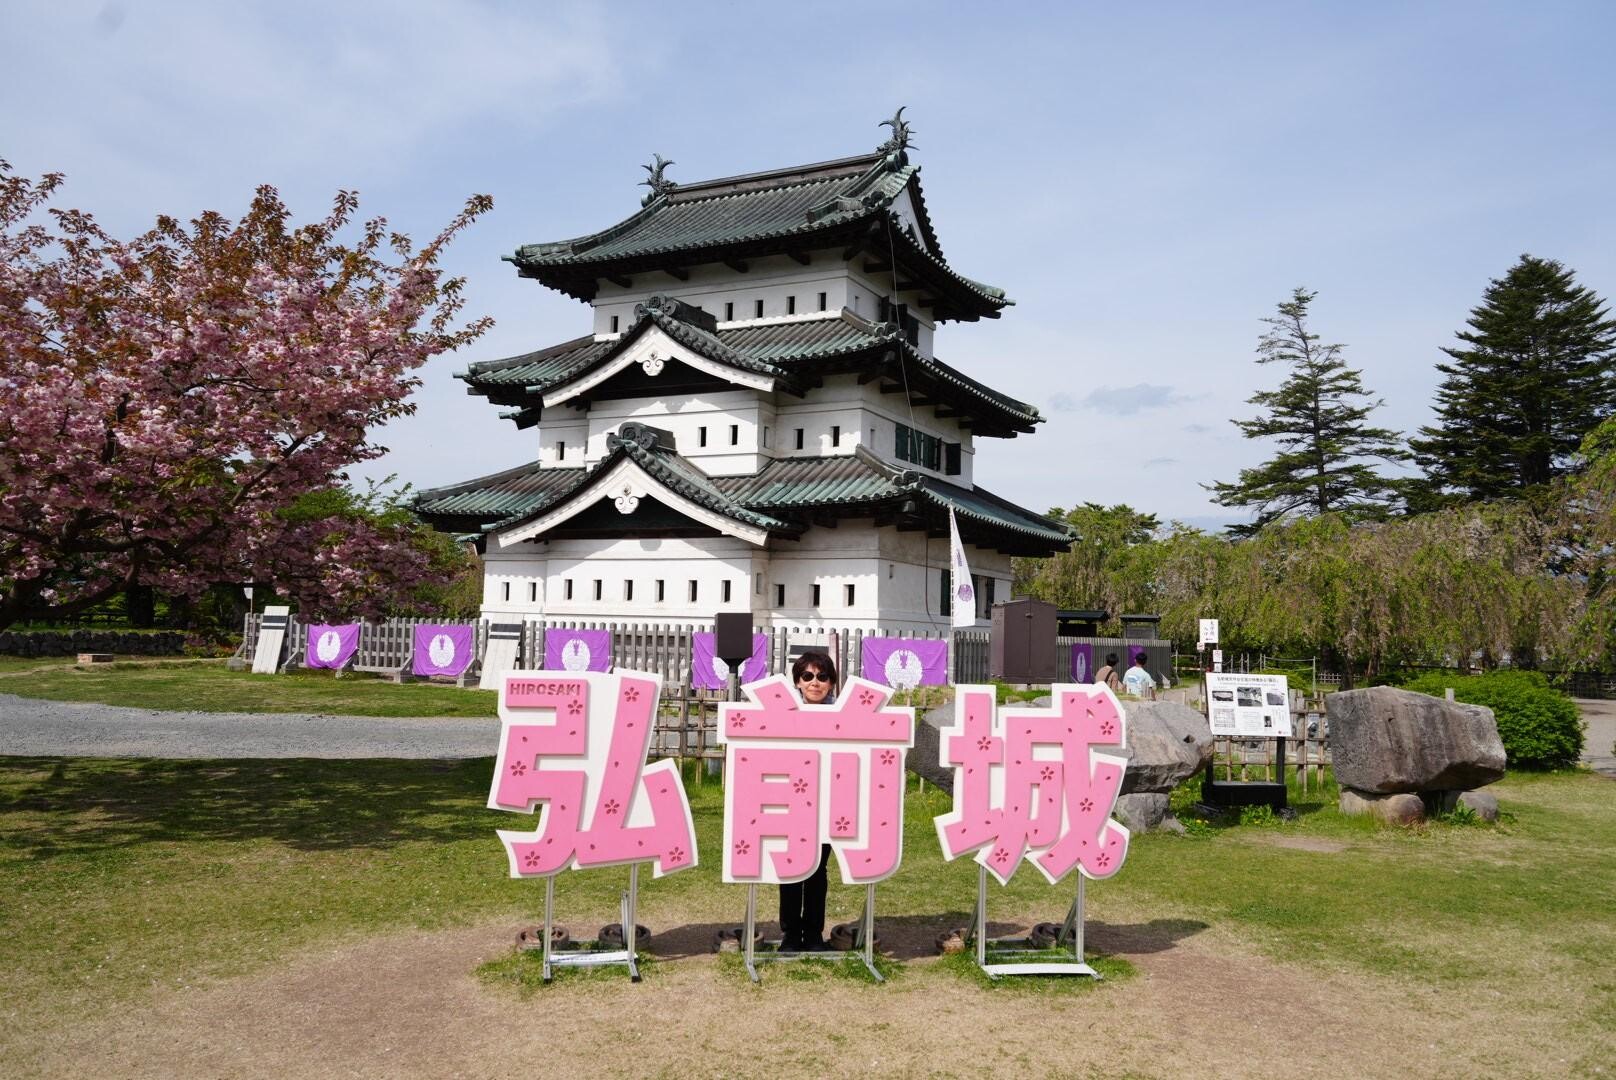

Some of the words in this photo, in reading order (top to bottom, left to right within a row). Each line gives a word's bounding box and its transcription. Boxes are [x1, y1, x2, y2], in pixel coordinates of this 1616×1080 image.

[510, 683, 581, 696] HIROSAKI
[495, 677, 1125, 879] 弘前城
